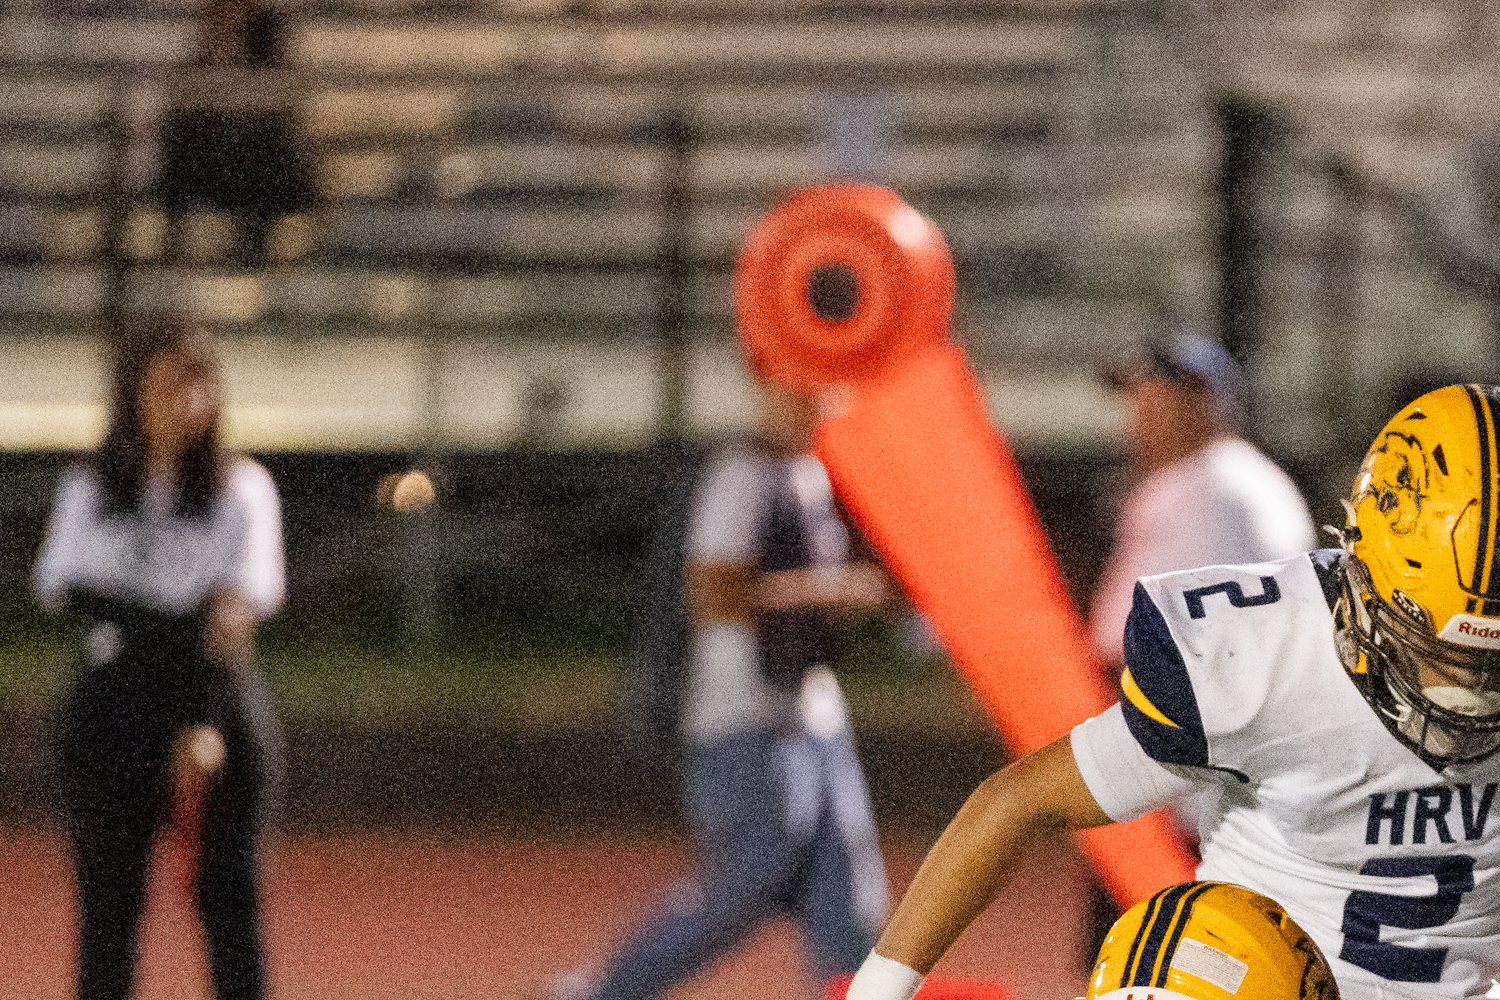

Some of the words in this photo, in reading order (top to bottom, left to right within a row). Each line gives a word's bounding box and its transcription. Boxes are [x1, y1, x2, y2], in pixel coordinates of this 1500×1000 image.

[1183, 576, 1281, 619] 2
[1366, 783, 1498, 845] HRV
[1339, 855, 1476, 983] 2
